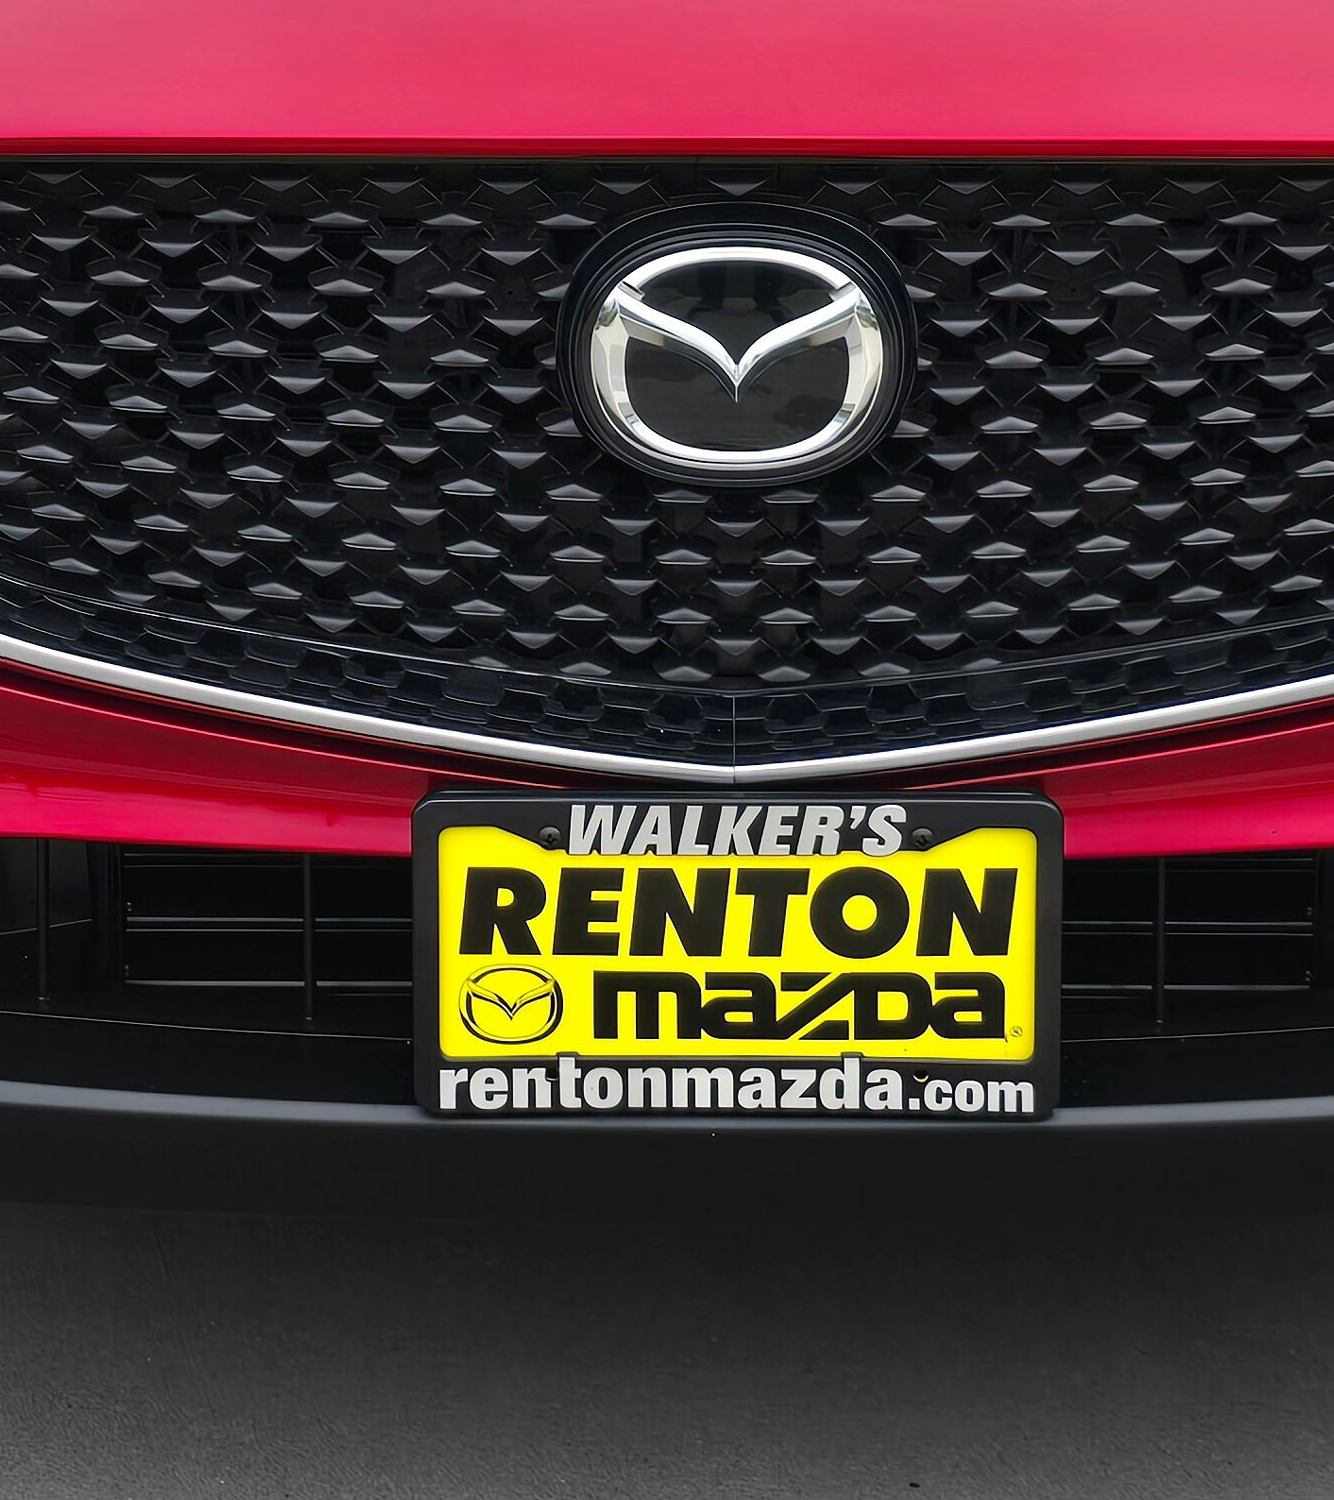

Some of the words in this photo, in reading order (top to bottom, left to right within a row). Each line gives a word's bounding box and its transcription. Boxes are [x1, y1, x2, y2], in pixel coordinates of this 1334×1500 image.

[568, 804, 907, 857] WALKER'S
[459, 866, 1018, 959] RENTON
[438, 1057, 1035, 1113] rentonmazda.com
